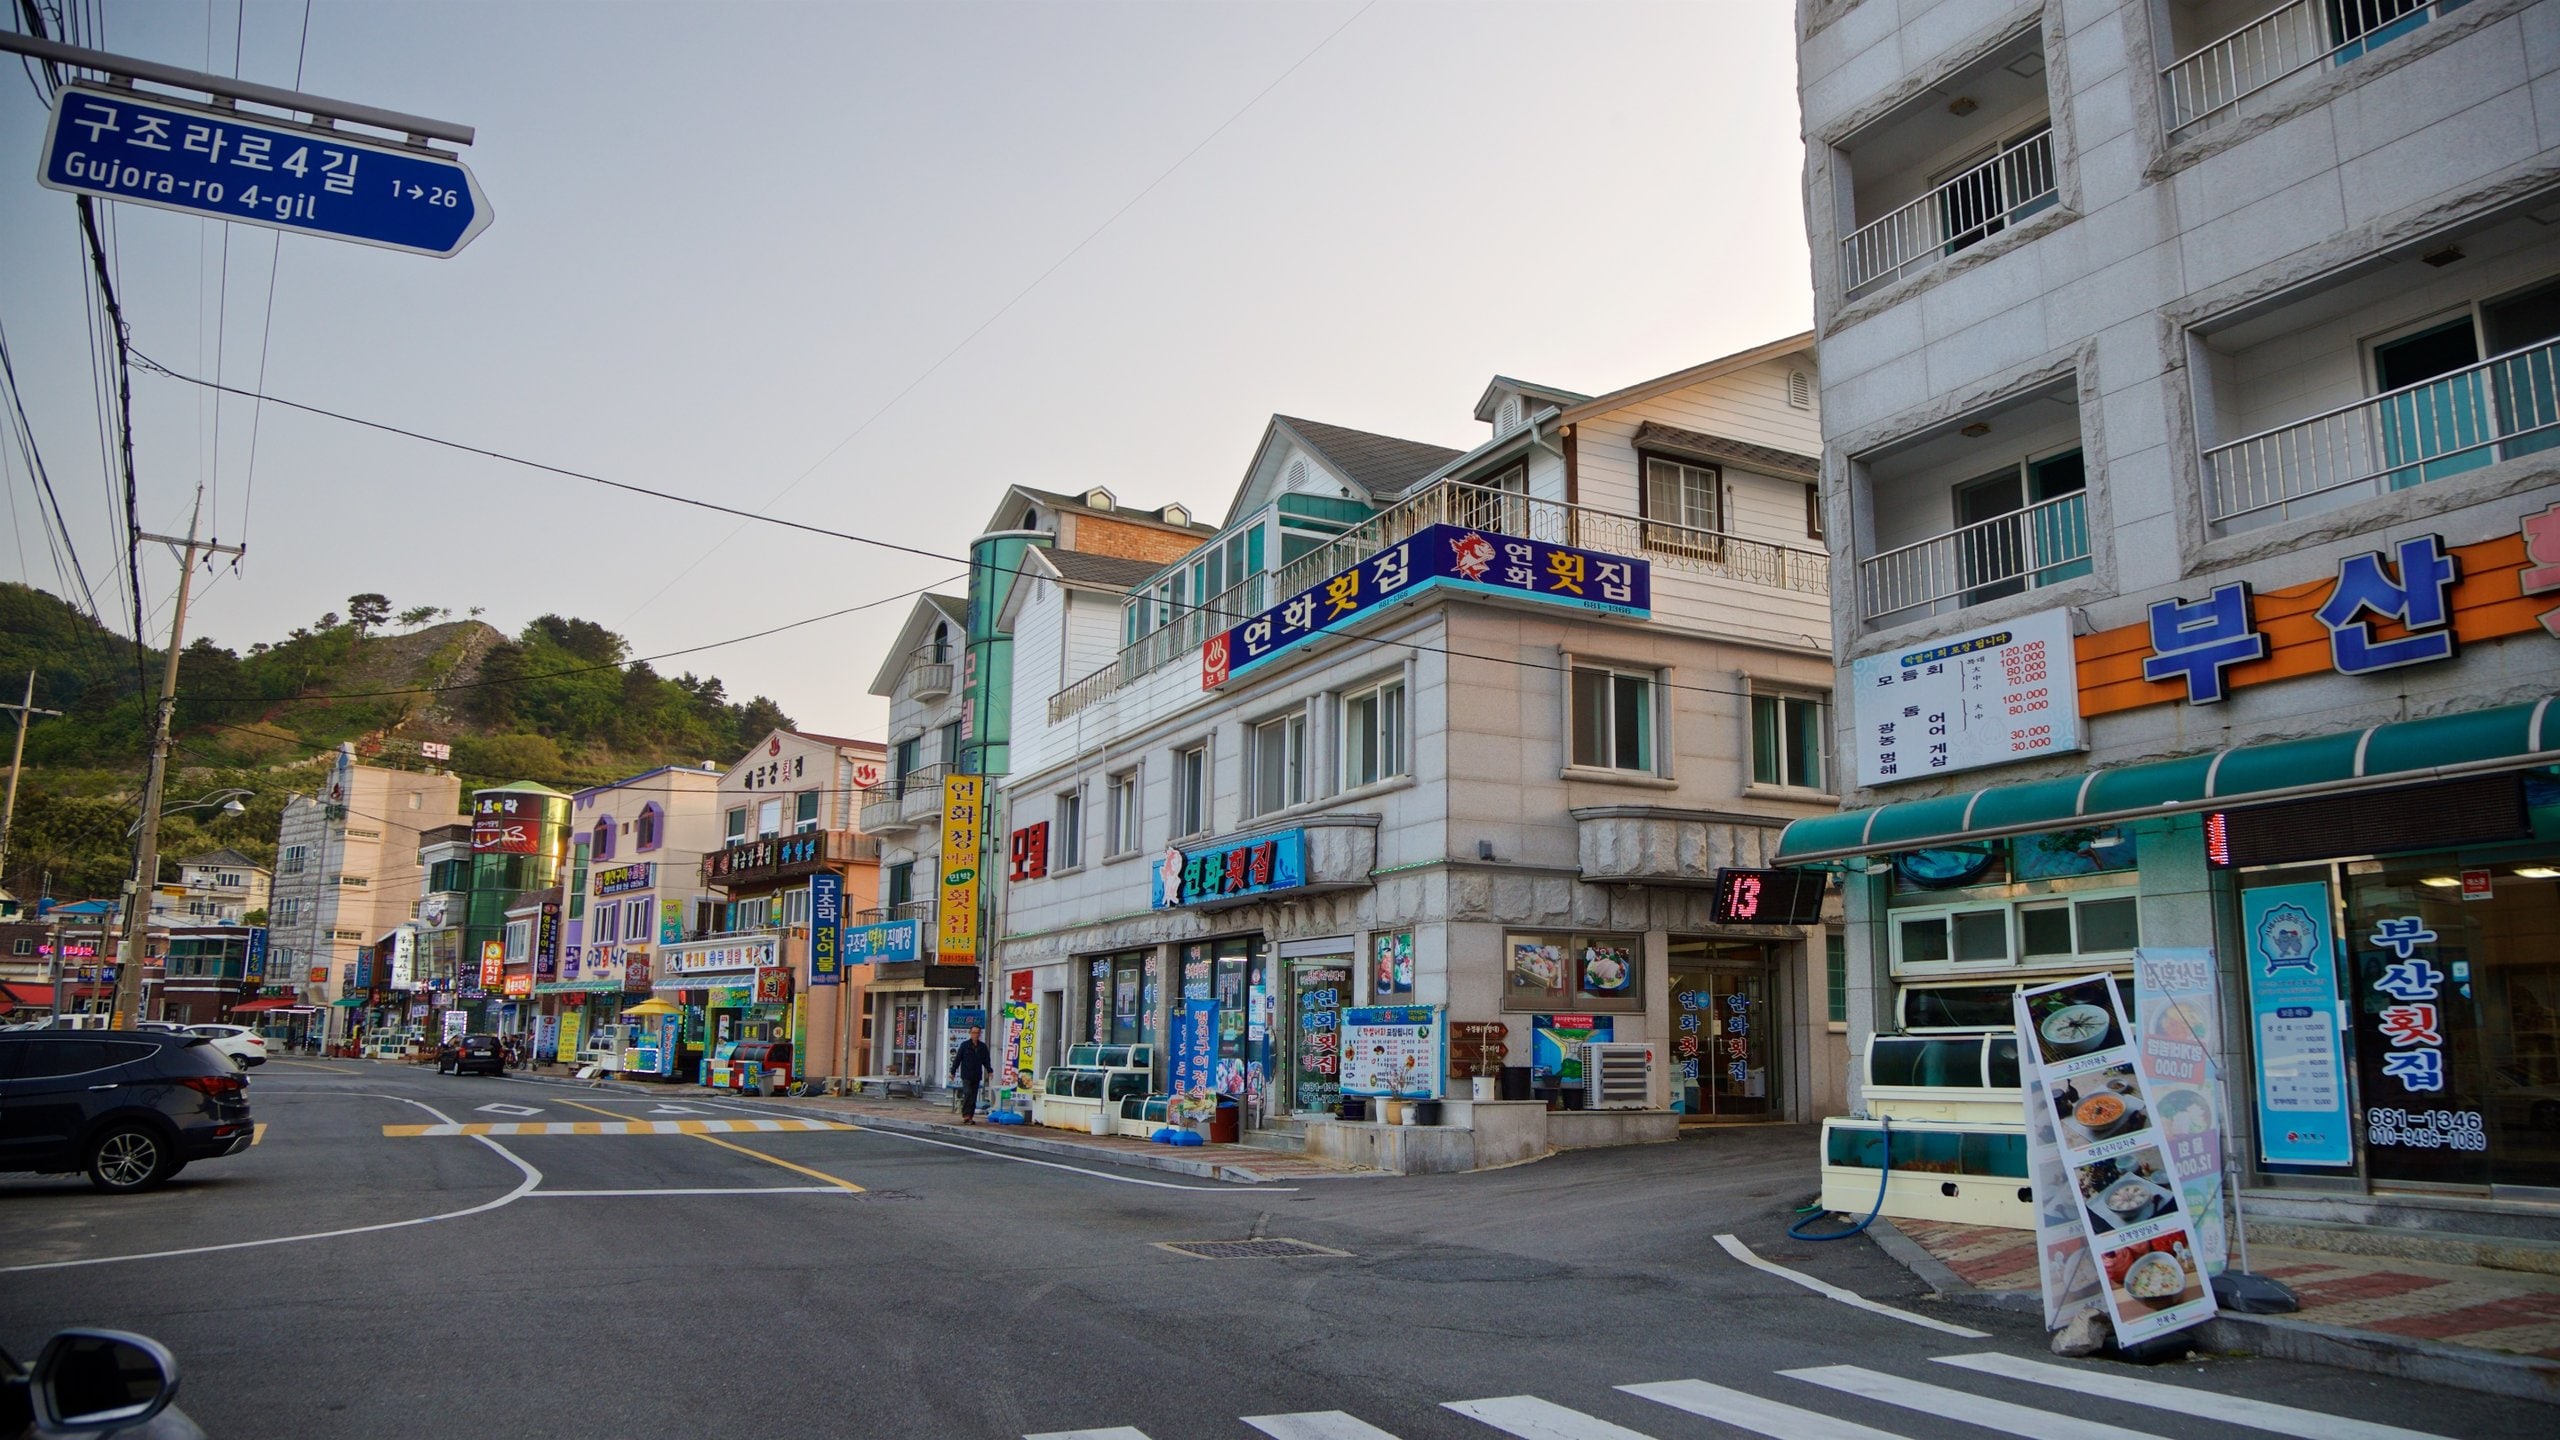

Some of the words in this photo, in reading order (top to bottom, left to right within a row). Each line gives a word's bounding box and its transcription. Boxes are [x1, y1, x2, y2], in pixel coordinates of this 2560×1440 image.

[74, 103, 360, 195] 구조라로4길
[65, 151, 225, 203] Gujora-ro
[239, 184, 317, 220] 4-gil
[1243, 543, 1409, 657] 연화횟집
[1583, 600, 1633, 615] 681-1366
[1975, 633, 2008, 650] 됩니다
[951, 781, 976, 849] 연화장
[1184, 839, 1272, 897] 연화횟집
[817, 879, 837, 923] 구조라
[817, 927, 835, 972] 건어물
[847, 932, 867, 954] 구조라
[2369, 916, 2445, 1092] 부산횟집
[1678, 989, 1702, 1080] 연화횟집
[1728, 992, 1750, 1082] 연화횟집
[2368, 1108, 2482, 1132] 681-1346
[2368, 1128, 2486, 1152] 010-9496-1089
